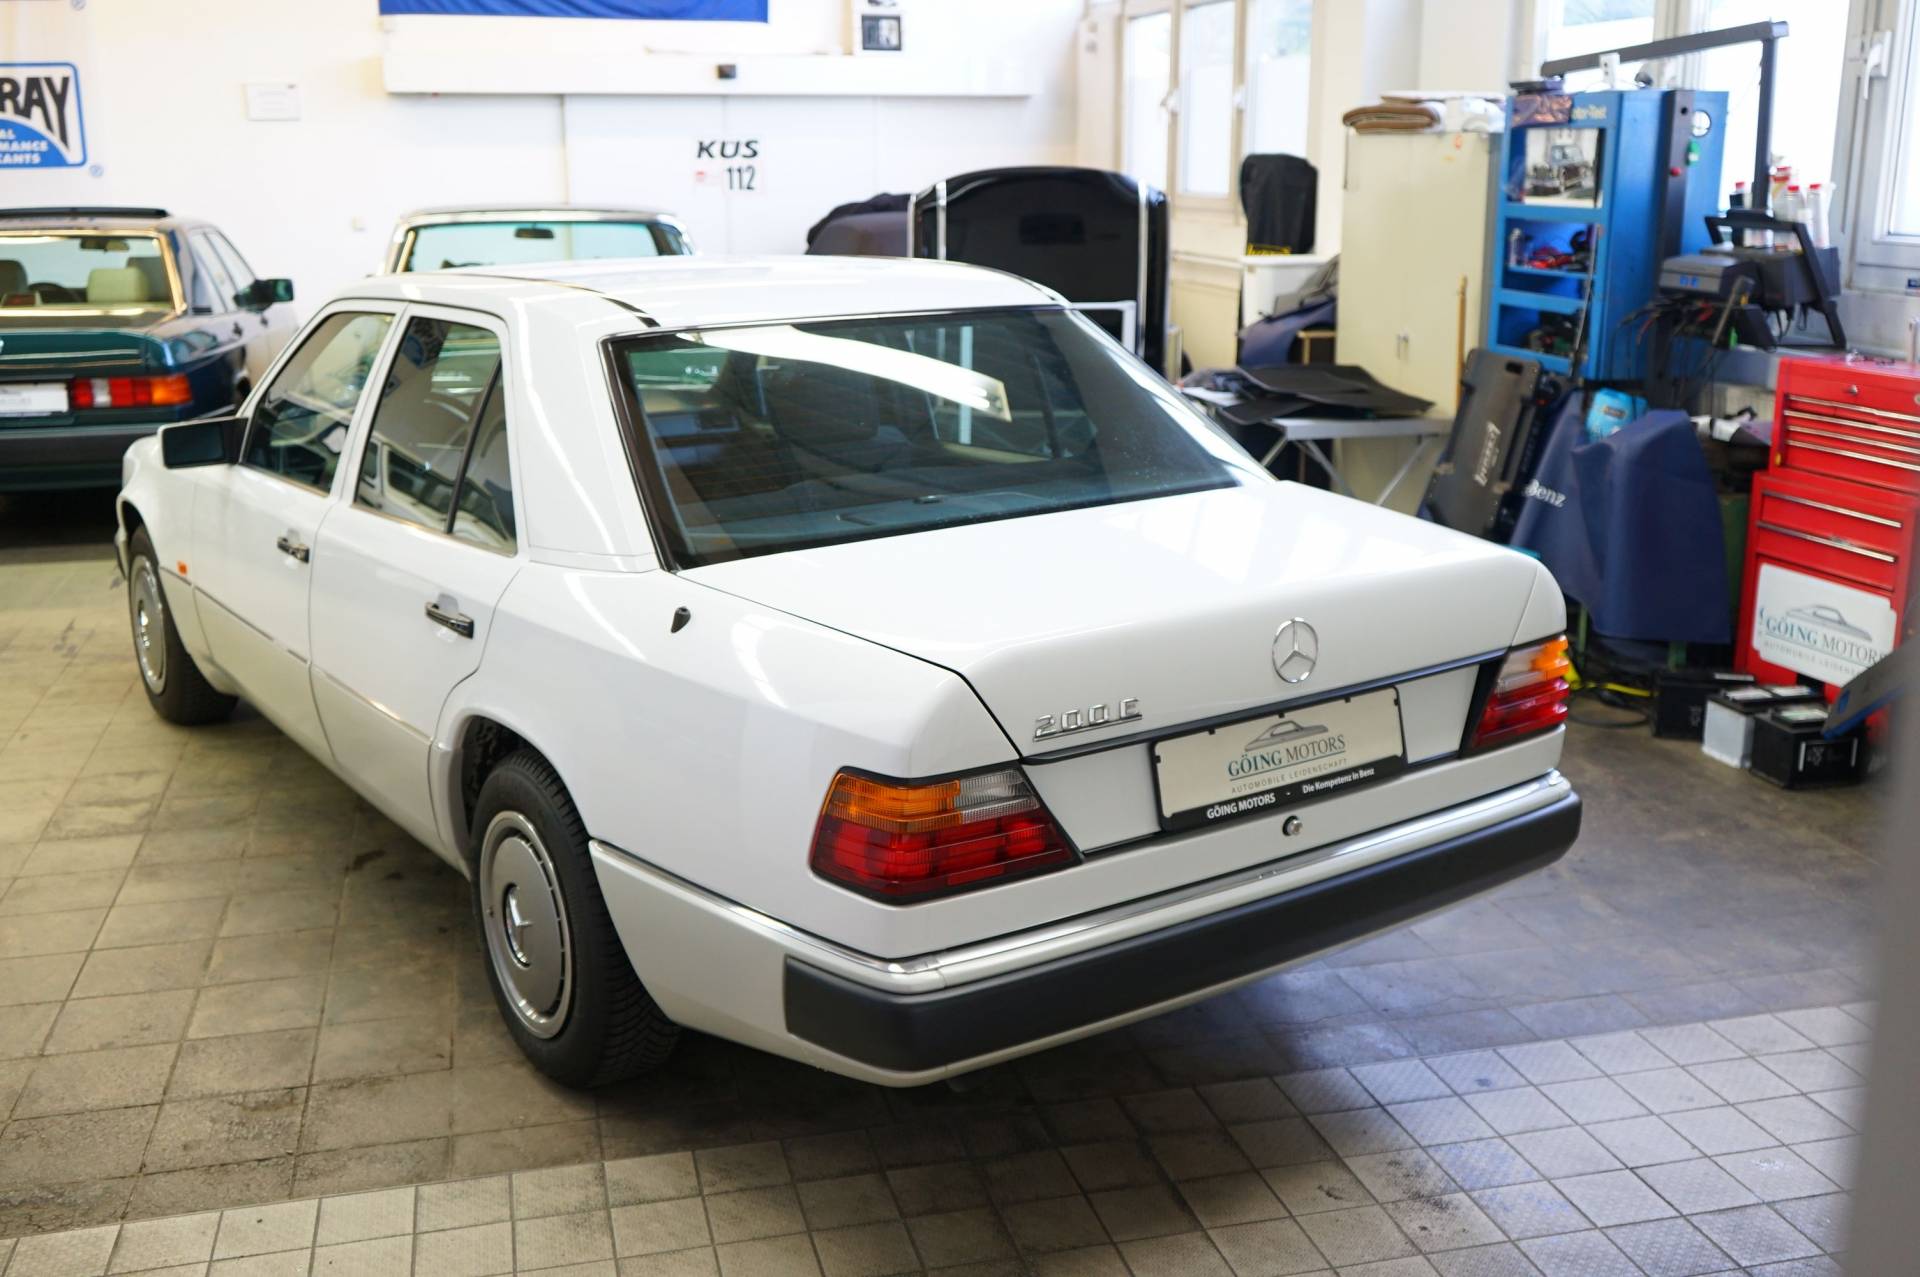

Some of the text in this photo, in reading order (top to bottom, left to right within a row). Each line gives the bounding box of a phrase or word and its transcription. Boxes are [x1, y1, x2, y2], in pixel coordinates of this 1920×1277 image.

[726, 164, 756, 191] 112
[1228, 734, 1347, 777] GÖING MOTORS
[1206, 767, 1375, 820] GÖING MOTORS Die Kompetenz in Benz
[1231, 774, 1286, 794] AUTOMOBILE
